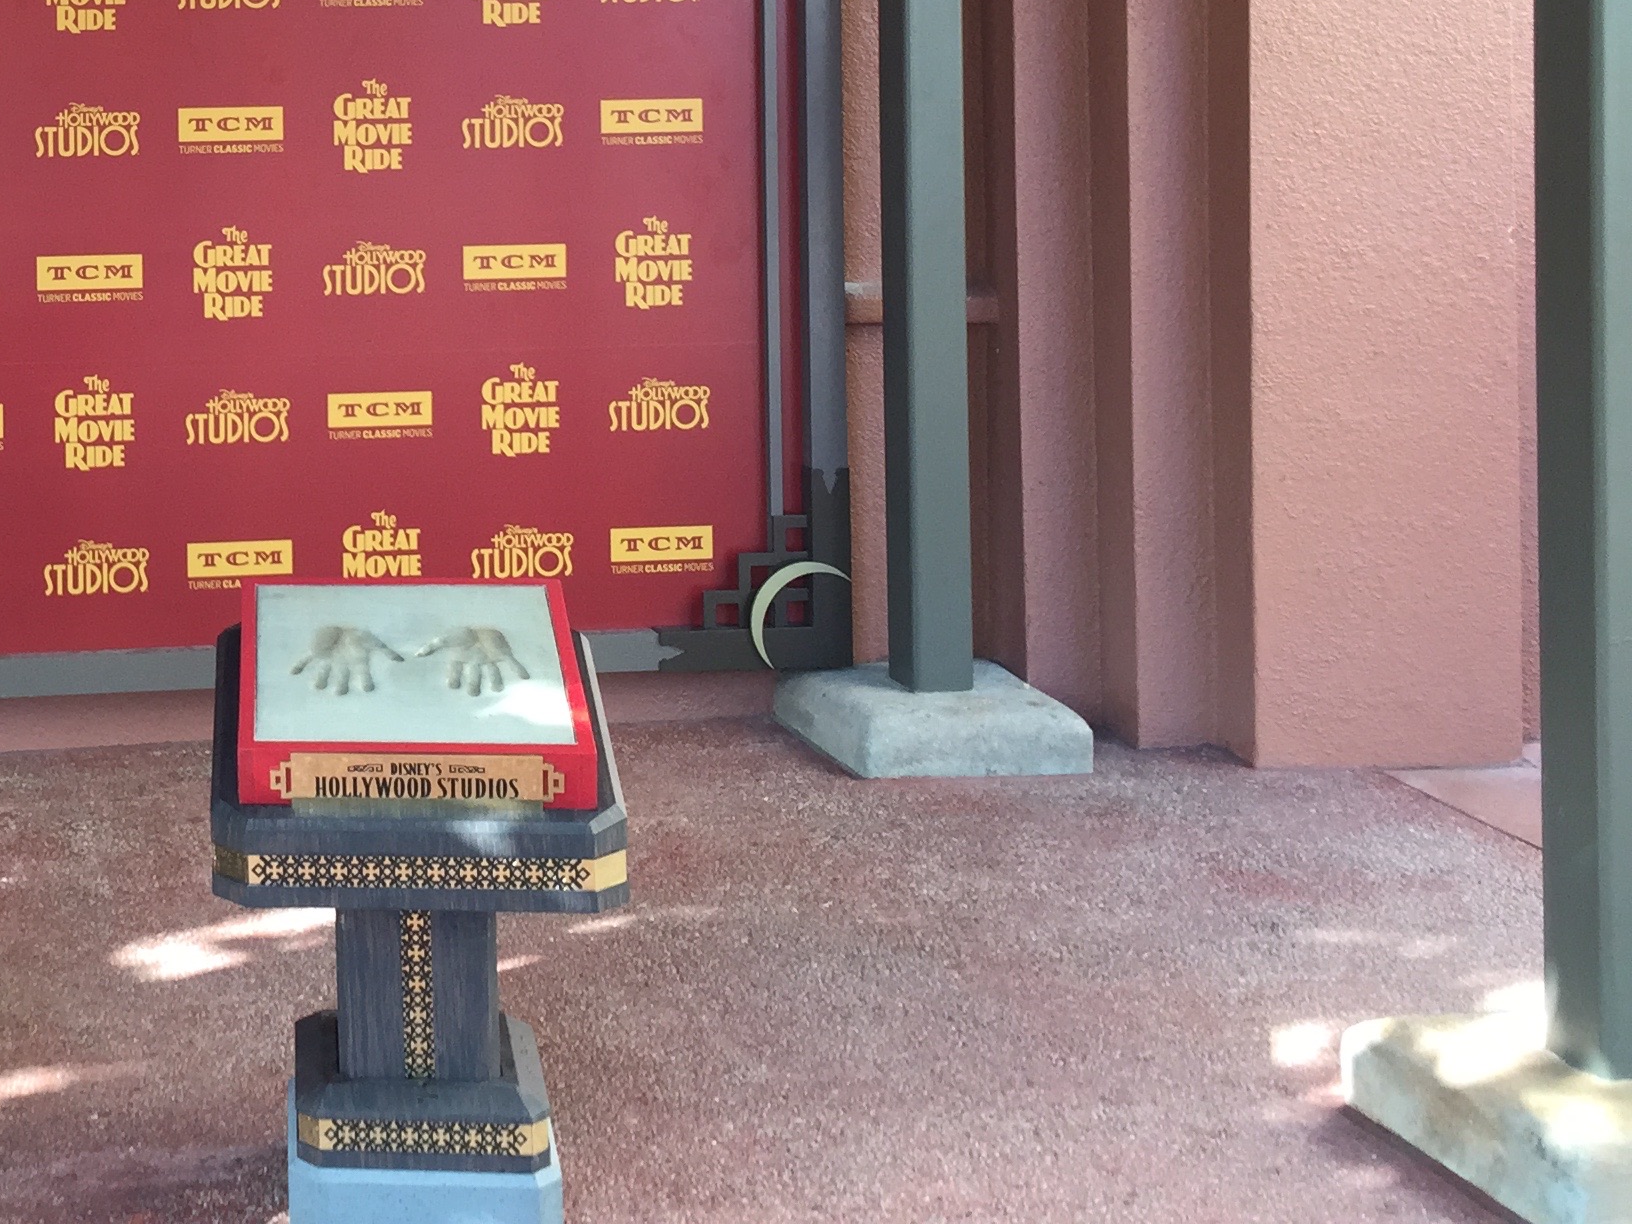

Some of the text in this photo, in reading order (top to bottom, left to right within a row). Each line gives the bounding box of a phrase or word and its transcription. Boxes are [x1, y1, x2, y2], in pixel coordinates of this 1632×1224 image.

[57, 6, 118, 34] RIDE
[482, 0, 541, 27] RIDE
[55, 110, 140, 128] HOLLYWOOD
[333, 94, 411, 121] GREAT
[481, 102, 564, 120] HOLLYWOOD
[610, 109, 694, 123] TCM
[189, 117, 273, 132] TCM
[333, 120, 412, 147] MOVIE
[461, 117, 563, 148] STUDIOS
[35, 126, 139, 157] STUDIOS
[344, 145, 404, 173] RIDE
[193, 241, 271, 269] GREAT
[615, 231, 691, 259] GREAT
[47, 265, 132, 280] TCM
[473, 254, 557, 269] TCM
[615, 257, 692, 284] MOVIE
[193, 267, 272, 294] MOVIE
[323, 264, 425, 296] STUDIOS
[204, 292, 264, 321] RIDE
[625, 282, 684, 310] RIDE
[510, 361, 536, 379] The
[55, 390, 134, 418] GREAT
[481, 378, 559, 405] GREAT
[205, 397, 291, 415] HOLLYWOOD
[338, 402, 422, 417] TCM
[481, 404, 560, 431] MOVIE
[609, 400, 709, 431] STUDIOS
[55, 417, 135, 444] MOVIE
[185, 413, 290, 445] STUDIOS
[66, 442, 127, 471] RIDE
[492, 429, 552, 457] RIDE
[343, 526, 420, 553] GREAT
[491, 531, 574, 549] HOLLYWOOD
[620, 536, 703, 551] TCM
[198, 550, 282, 566] TCM
[343, 552, 421, 579] MOVIE
[471, 547, 573, 579] STUDIOS
[611, 563, 713, 574] TURNER CLASSIC MOVIES
[44, 563, 148, 596] STUDIOS
[390, 763, 443, 776] DISNEY'S
[314, 776, 520, 799] HOLLYWOOD STUDIOS
